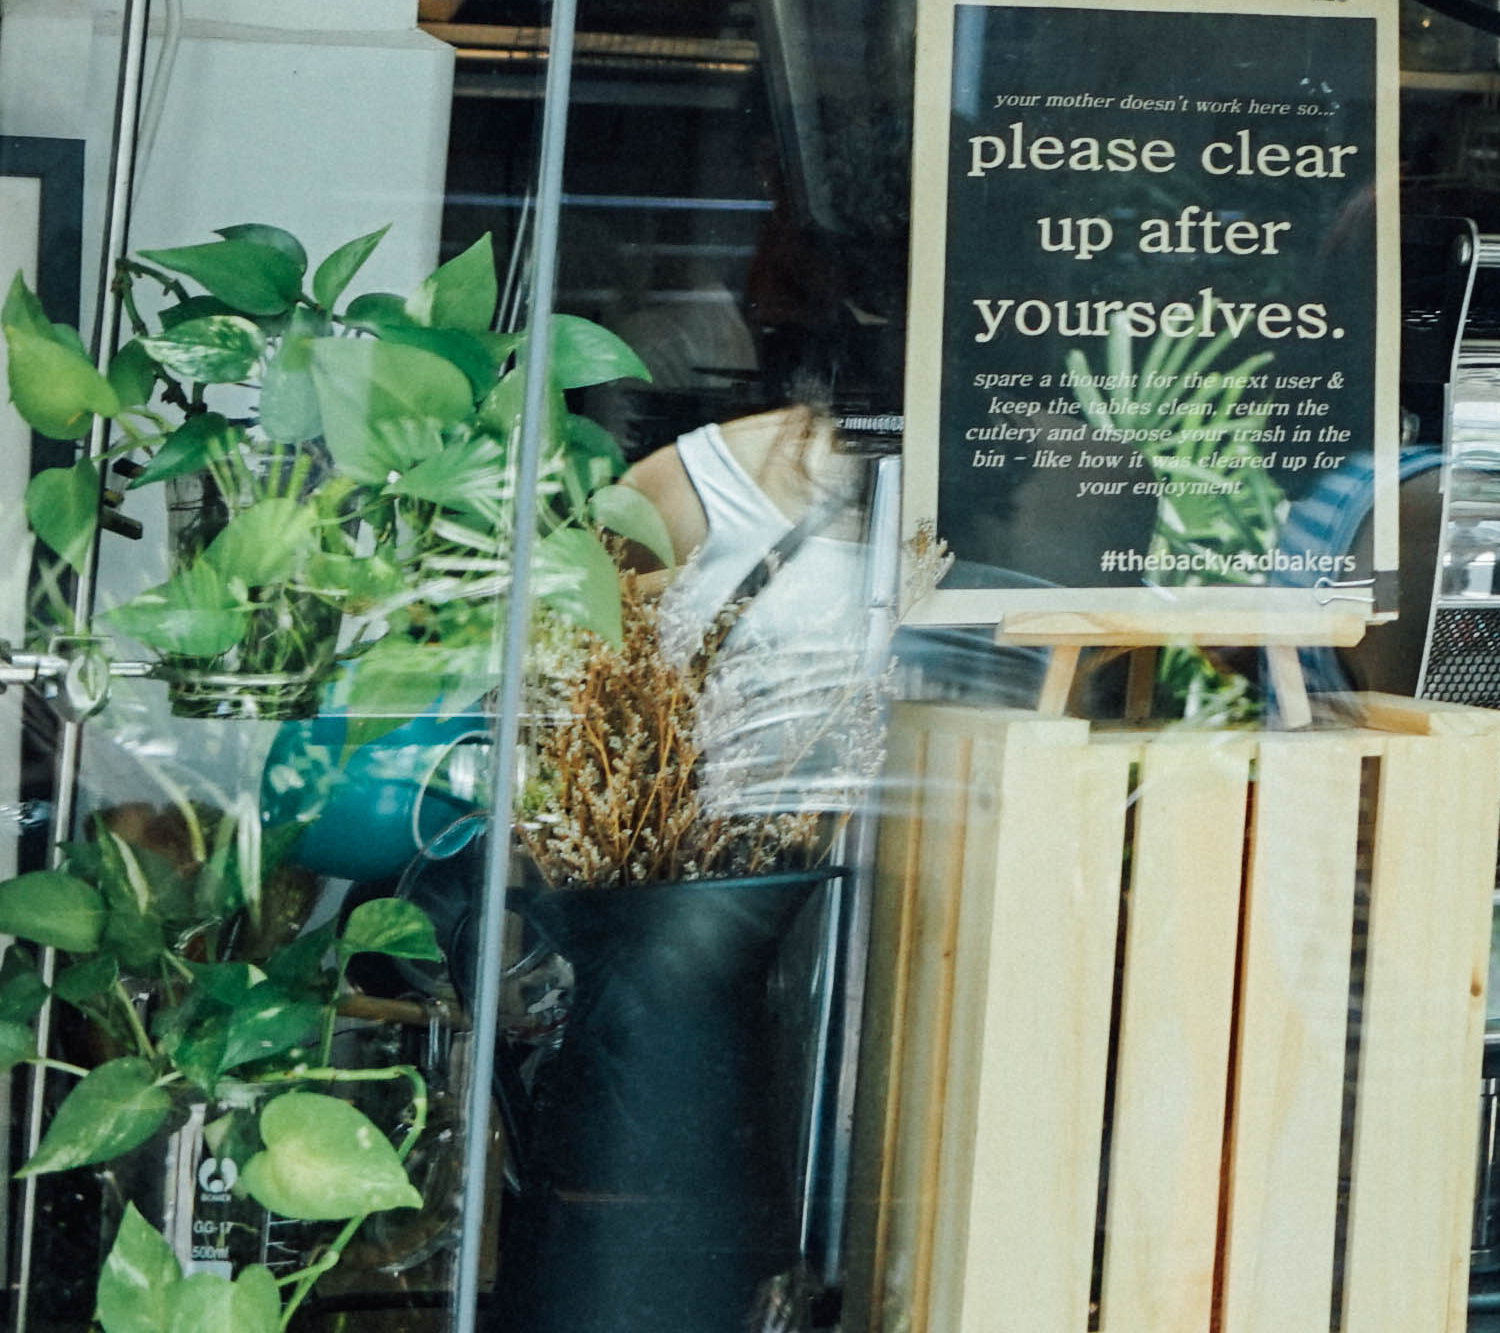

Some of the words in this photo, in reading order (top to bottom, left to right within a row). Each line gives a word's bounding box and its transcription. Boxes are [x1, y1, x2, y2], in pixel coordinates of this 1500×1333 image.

[993, 92, 1041, 109] your
[1045, 92, 1115, 109] mother
[1119, 94, 1189, 112] doesn't
[1195, 98, 1243, 115] work
[1248, 99, 1291, 116] here
[967, 122, 1177, 177] please
[1201, 129, 1359, 178] clear
[1036, 214, 1114, 260] up
[1139, 205, 1292, 255] after
[973, 287, 1345, 343] yourselves.
[974, 372, 1034, 390] spare
[1039, 375, 1052, 388] a
[1058, 371, 1138, 390] thought
[1143, 371, 1178, 389] for
[1183, 372, 1217, 389] the
[1222, 373, 1269, 389] next
[1274, 375, 1322, 389] user
[1326, 374, 1345, 390] &
[988, 398, 1041, 417] keep
[1047, 398, 1081, 416] the
[1087, 398, 1152, 416] tables
[1224, 400, 1291, 417] return
[1296, 400, 1330, 417] the
[965, 424, 1042, 444] cutlery
[1047, 424, 1086, 442] and
[1092, 424, 1175, 444] dispose
[1177, 428, 1233, 445] your
[1233, 425, 1287, 443] trash
[1291, 426, 1313, 443] in
[1318, 426, 1352, 443] the
[972, 450, 1006, 468] bin
[1032, 450, 1073, 469] like
[1078, 450, 1124, 469] how
[1128, 451, 1145, 469] it
[1151, 455, 1193, 469] was
[1197, 451, 1276, 469] cleared
[1281, 455, 1308, 472] up
[1312, 451, 1346, 469] for
[1076, 481, 1128, 497] your
[1132, 478, 1242, 497] enjoyment
[1100, 548, 1357, 573] #thebackyardbakers
